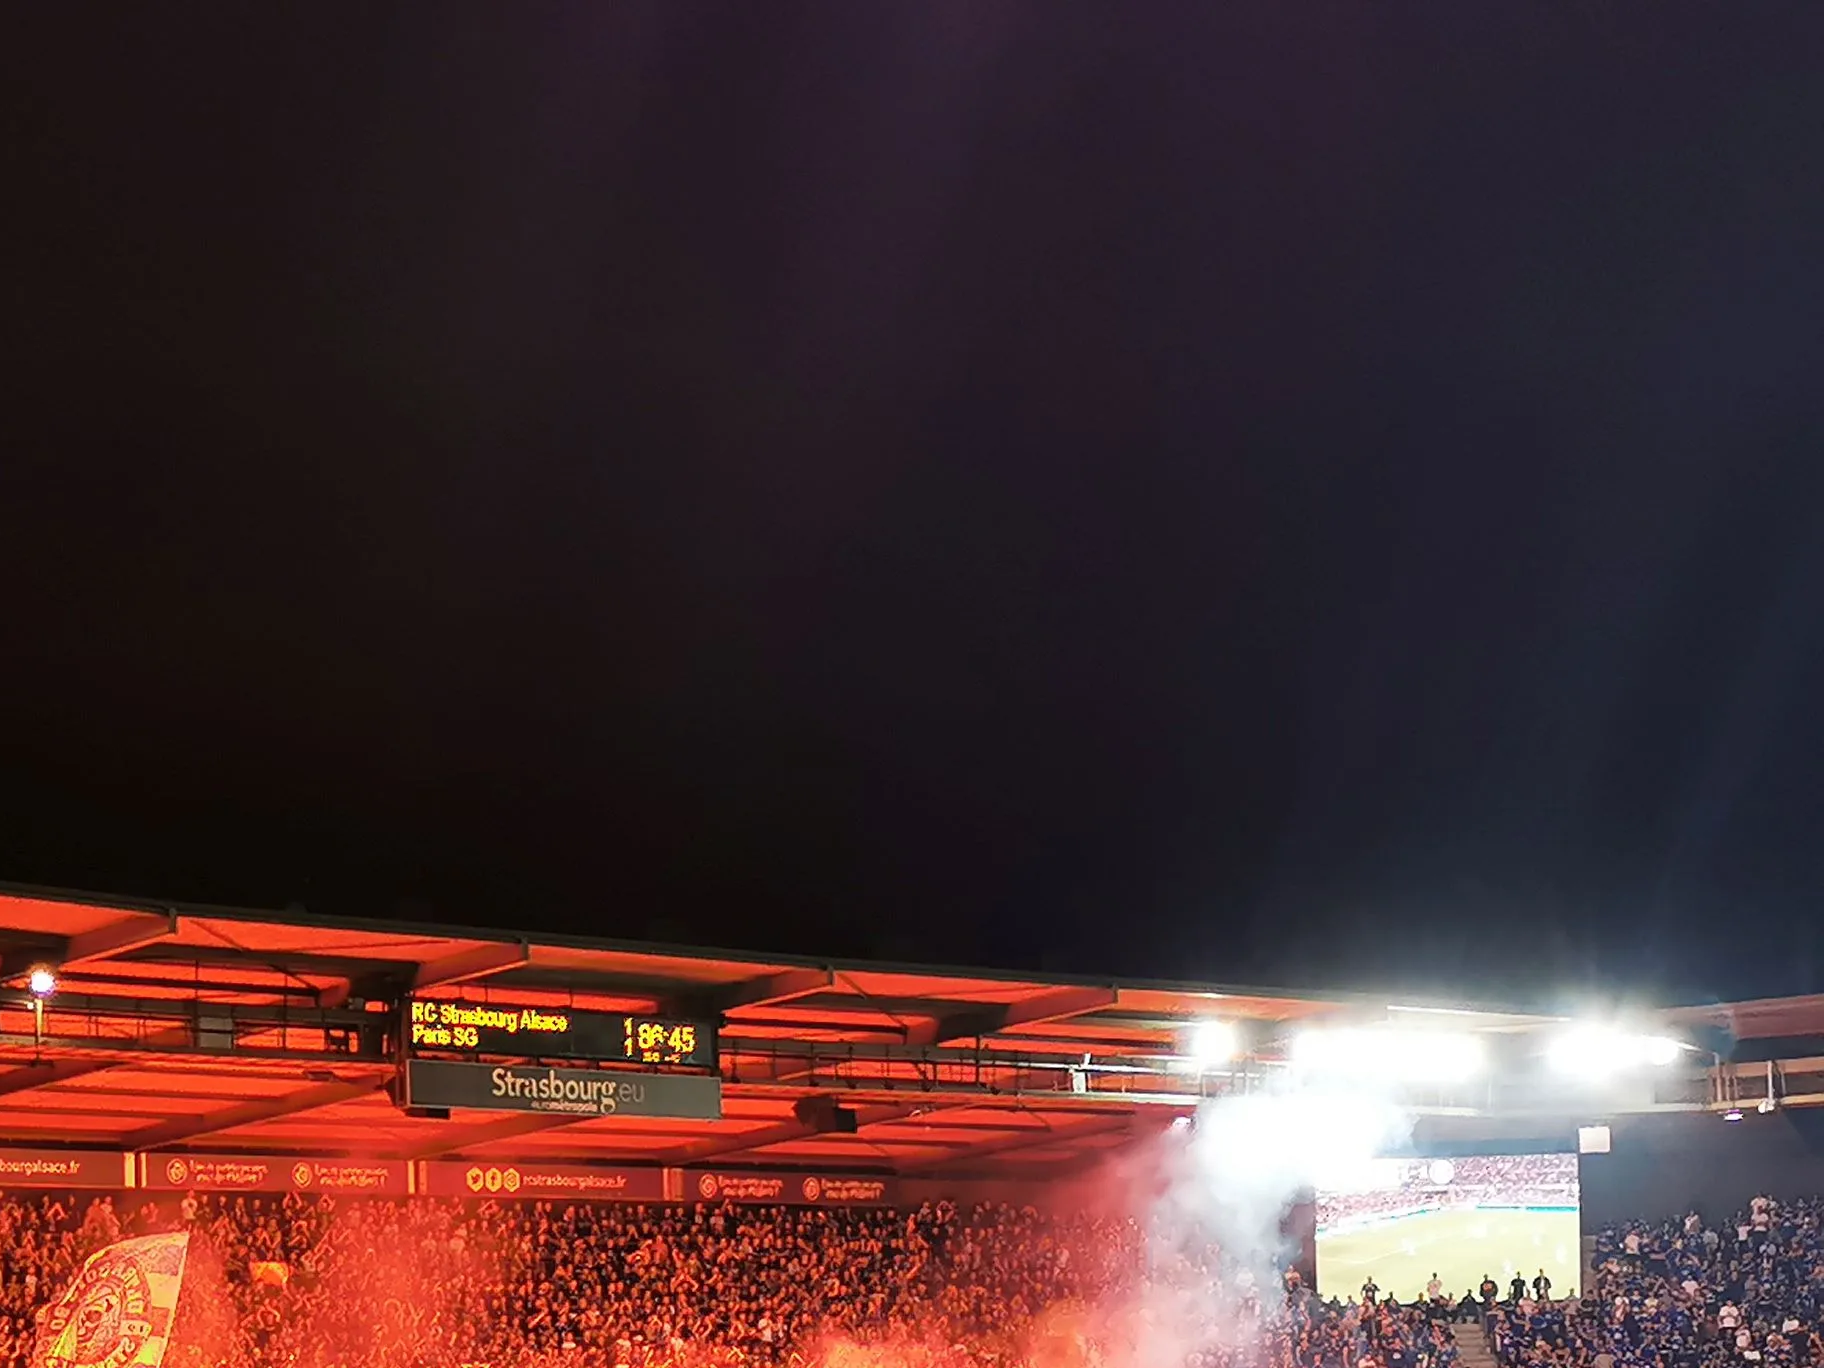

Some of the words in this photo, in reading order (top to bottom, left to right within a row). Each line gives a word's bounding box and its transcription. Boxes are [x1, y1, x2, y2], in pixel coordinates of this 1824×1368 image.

[412, 1002, 438, 1024] RC
[441, 1004, 517, 1032] Strasbourg
[520, 1011, 567, 1032] Alsace
[412, 1024, 451, 1044] Paris
[453, 1027, 479, 1047] SG
